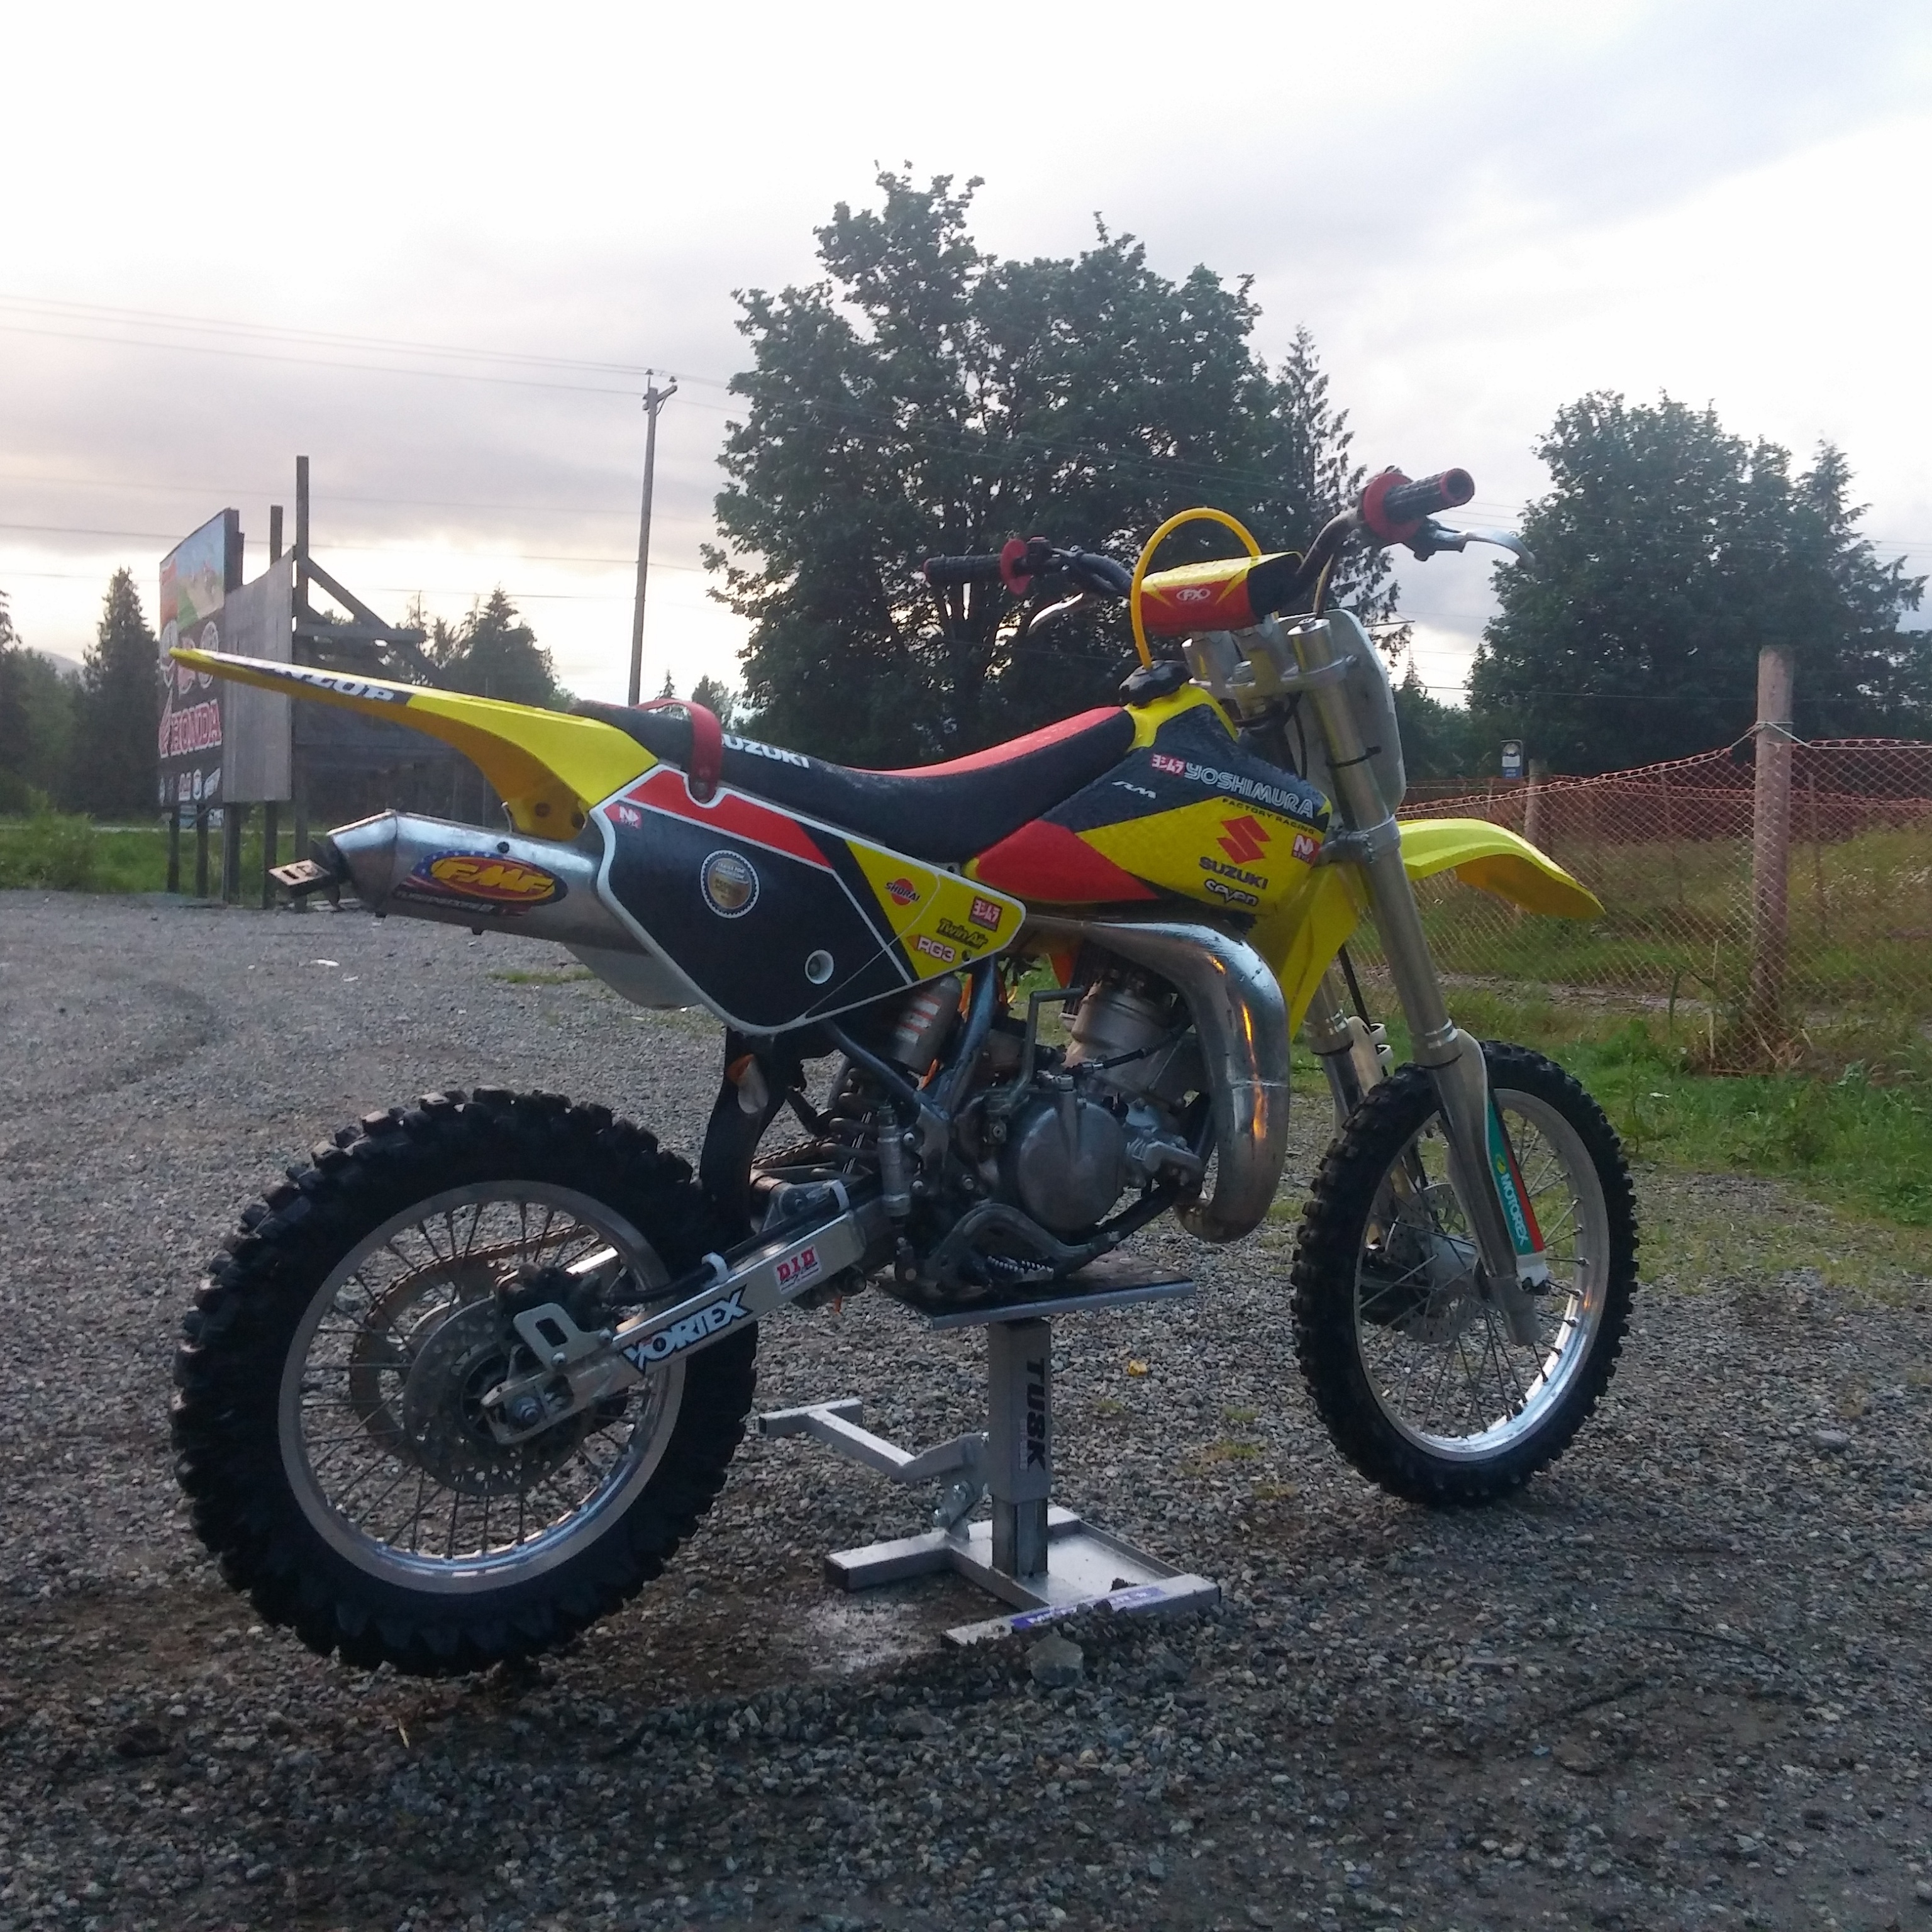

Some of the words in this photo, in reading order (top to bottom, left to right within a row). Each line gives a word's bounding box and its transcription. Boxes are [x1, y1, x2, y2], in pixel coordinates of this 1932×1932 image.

[170, 698, 222, 757] HONDA
[721, 733, 810, 769] UZUKI
[1184, 762, 1314, 819] YOSHIMURA
[1223, 799, 1272, 819] FACTORY
[1275, 816, 1314, 835] RACING
[433, 858, 555, 894] FMF
[1199, 856, 1269, 890] SUZUKI
[885, 882, 921, 902] SHORAI
[917, 936, 956, 963] RG3
[1500, 1172, 1530, 1246] MOTOREX
[623, 1284, 753, 1372] VORTEX
[1026, 1357, 1046, 1472] TUSK
